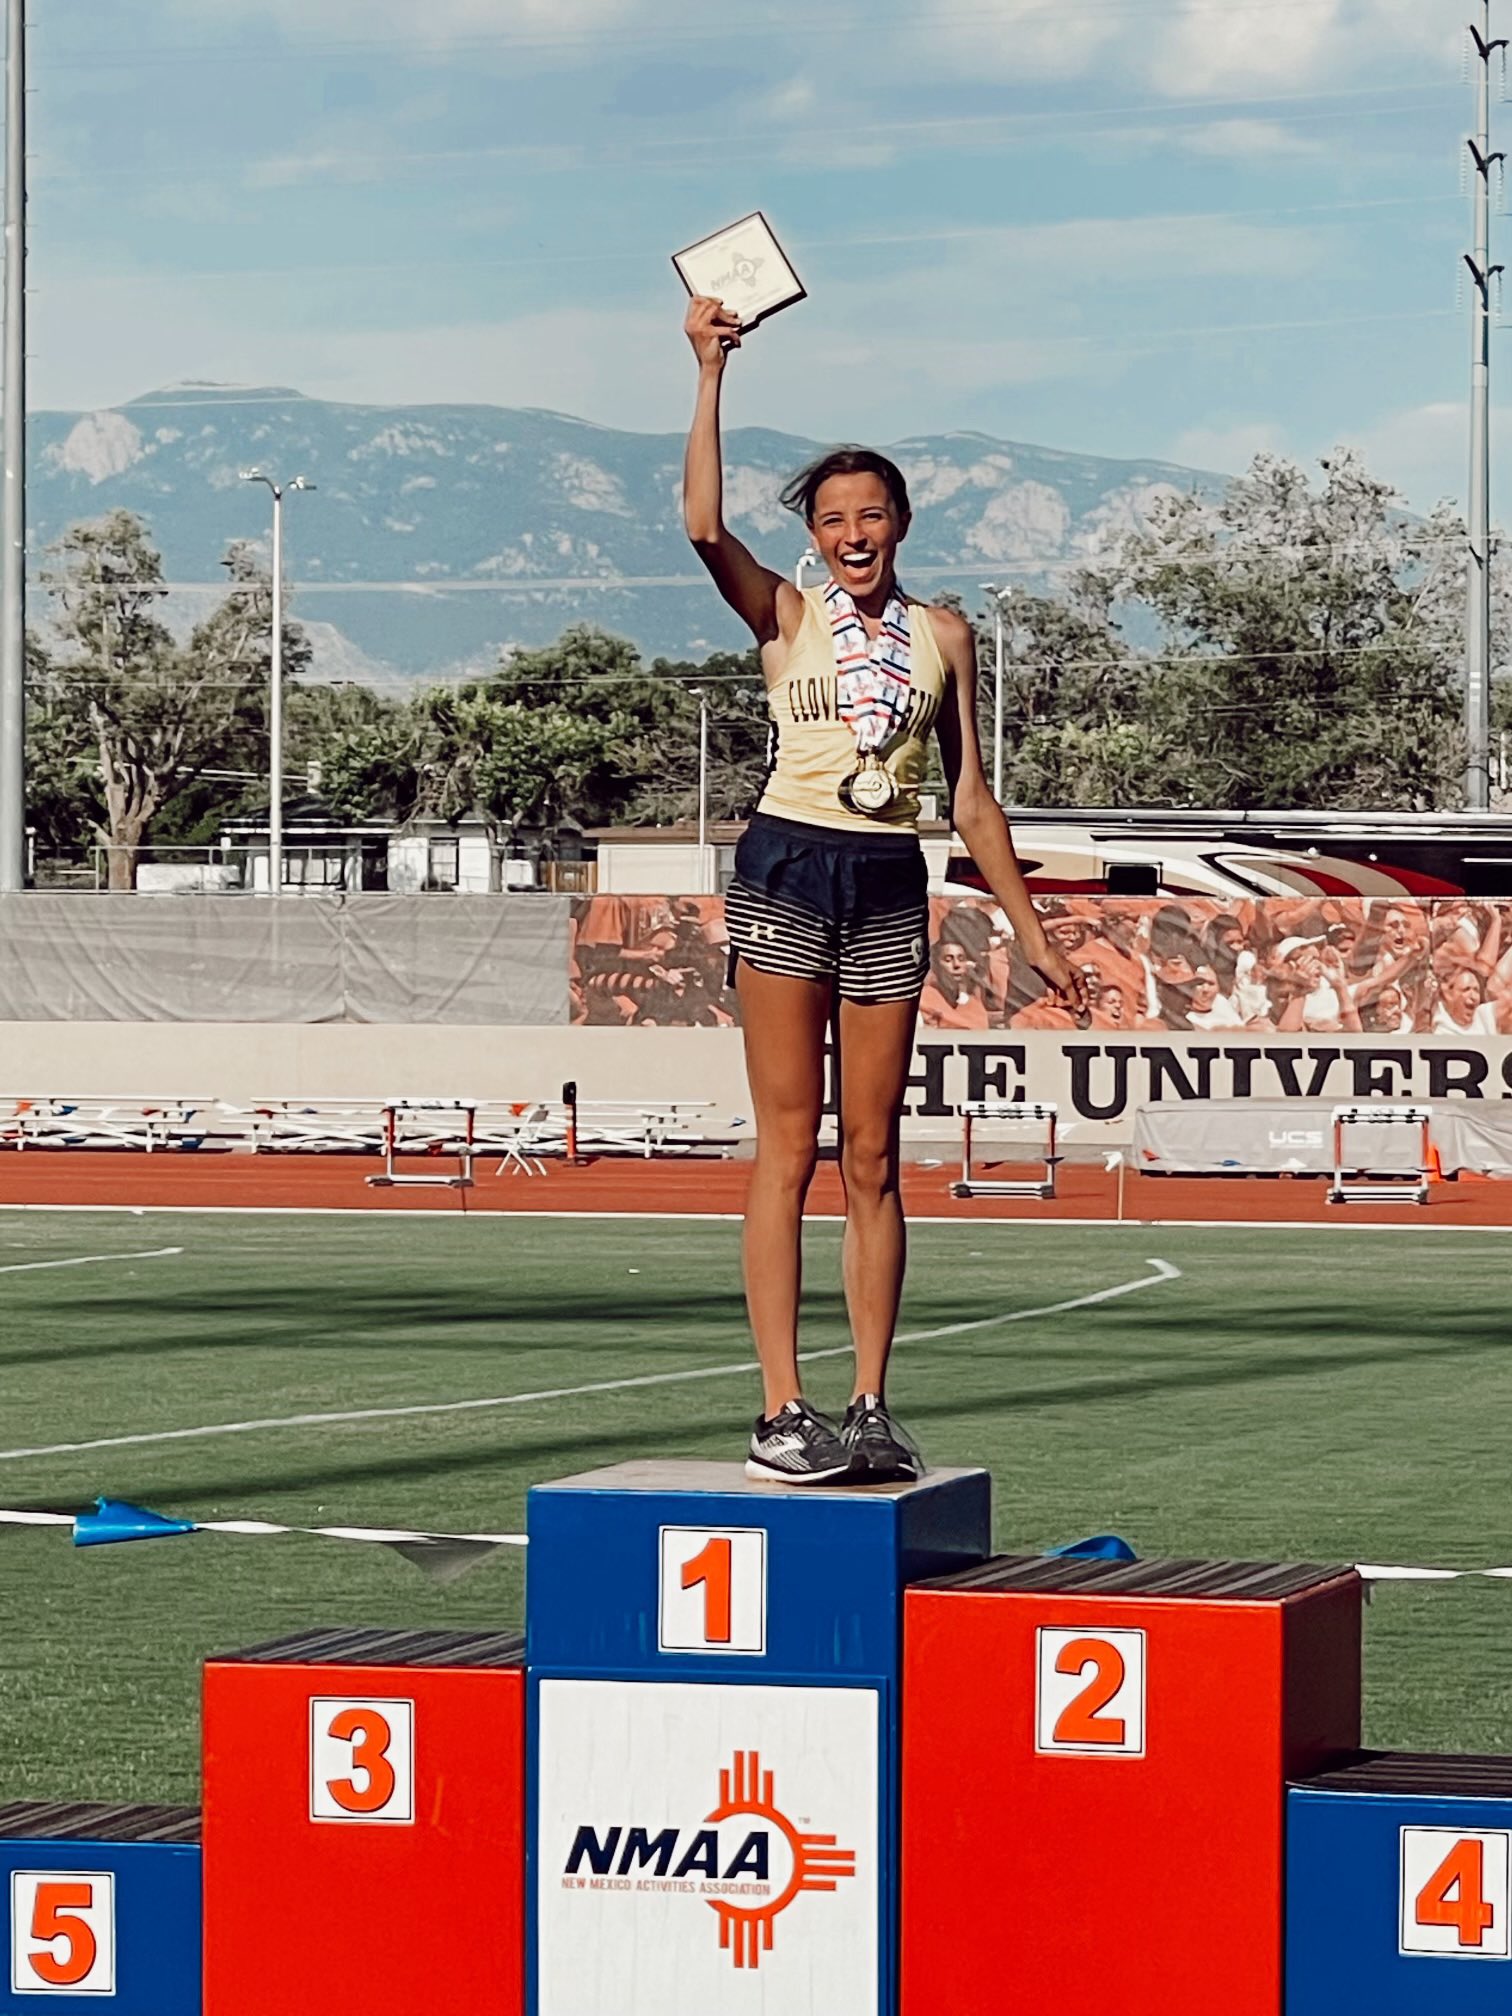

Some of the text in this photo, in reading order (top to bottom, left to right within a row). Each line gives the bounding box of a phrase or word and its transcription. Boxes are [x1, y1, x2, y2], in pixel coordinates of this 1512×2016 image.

[789, 676, 840, 722] CLOVI
[822, 1044, 1512, 1120] HE UNIVER
[1269, 1131, 1324, 1144] UCS
[682, 1538, 732, 1642] 1
[1053, 1638, 1125, 1744] 2
[327, 1709, 396, 1812] 3
[561, 1877, 771, 1895] NEW MEXICO ACTIVITIES ASSOCIATION
[564, 1826, 769, 1880] NMAA
[1415, 1839, 1494, 1946] 4
[28, 1883, 97, 1984] 5
